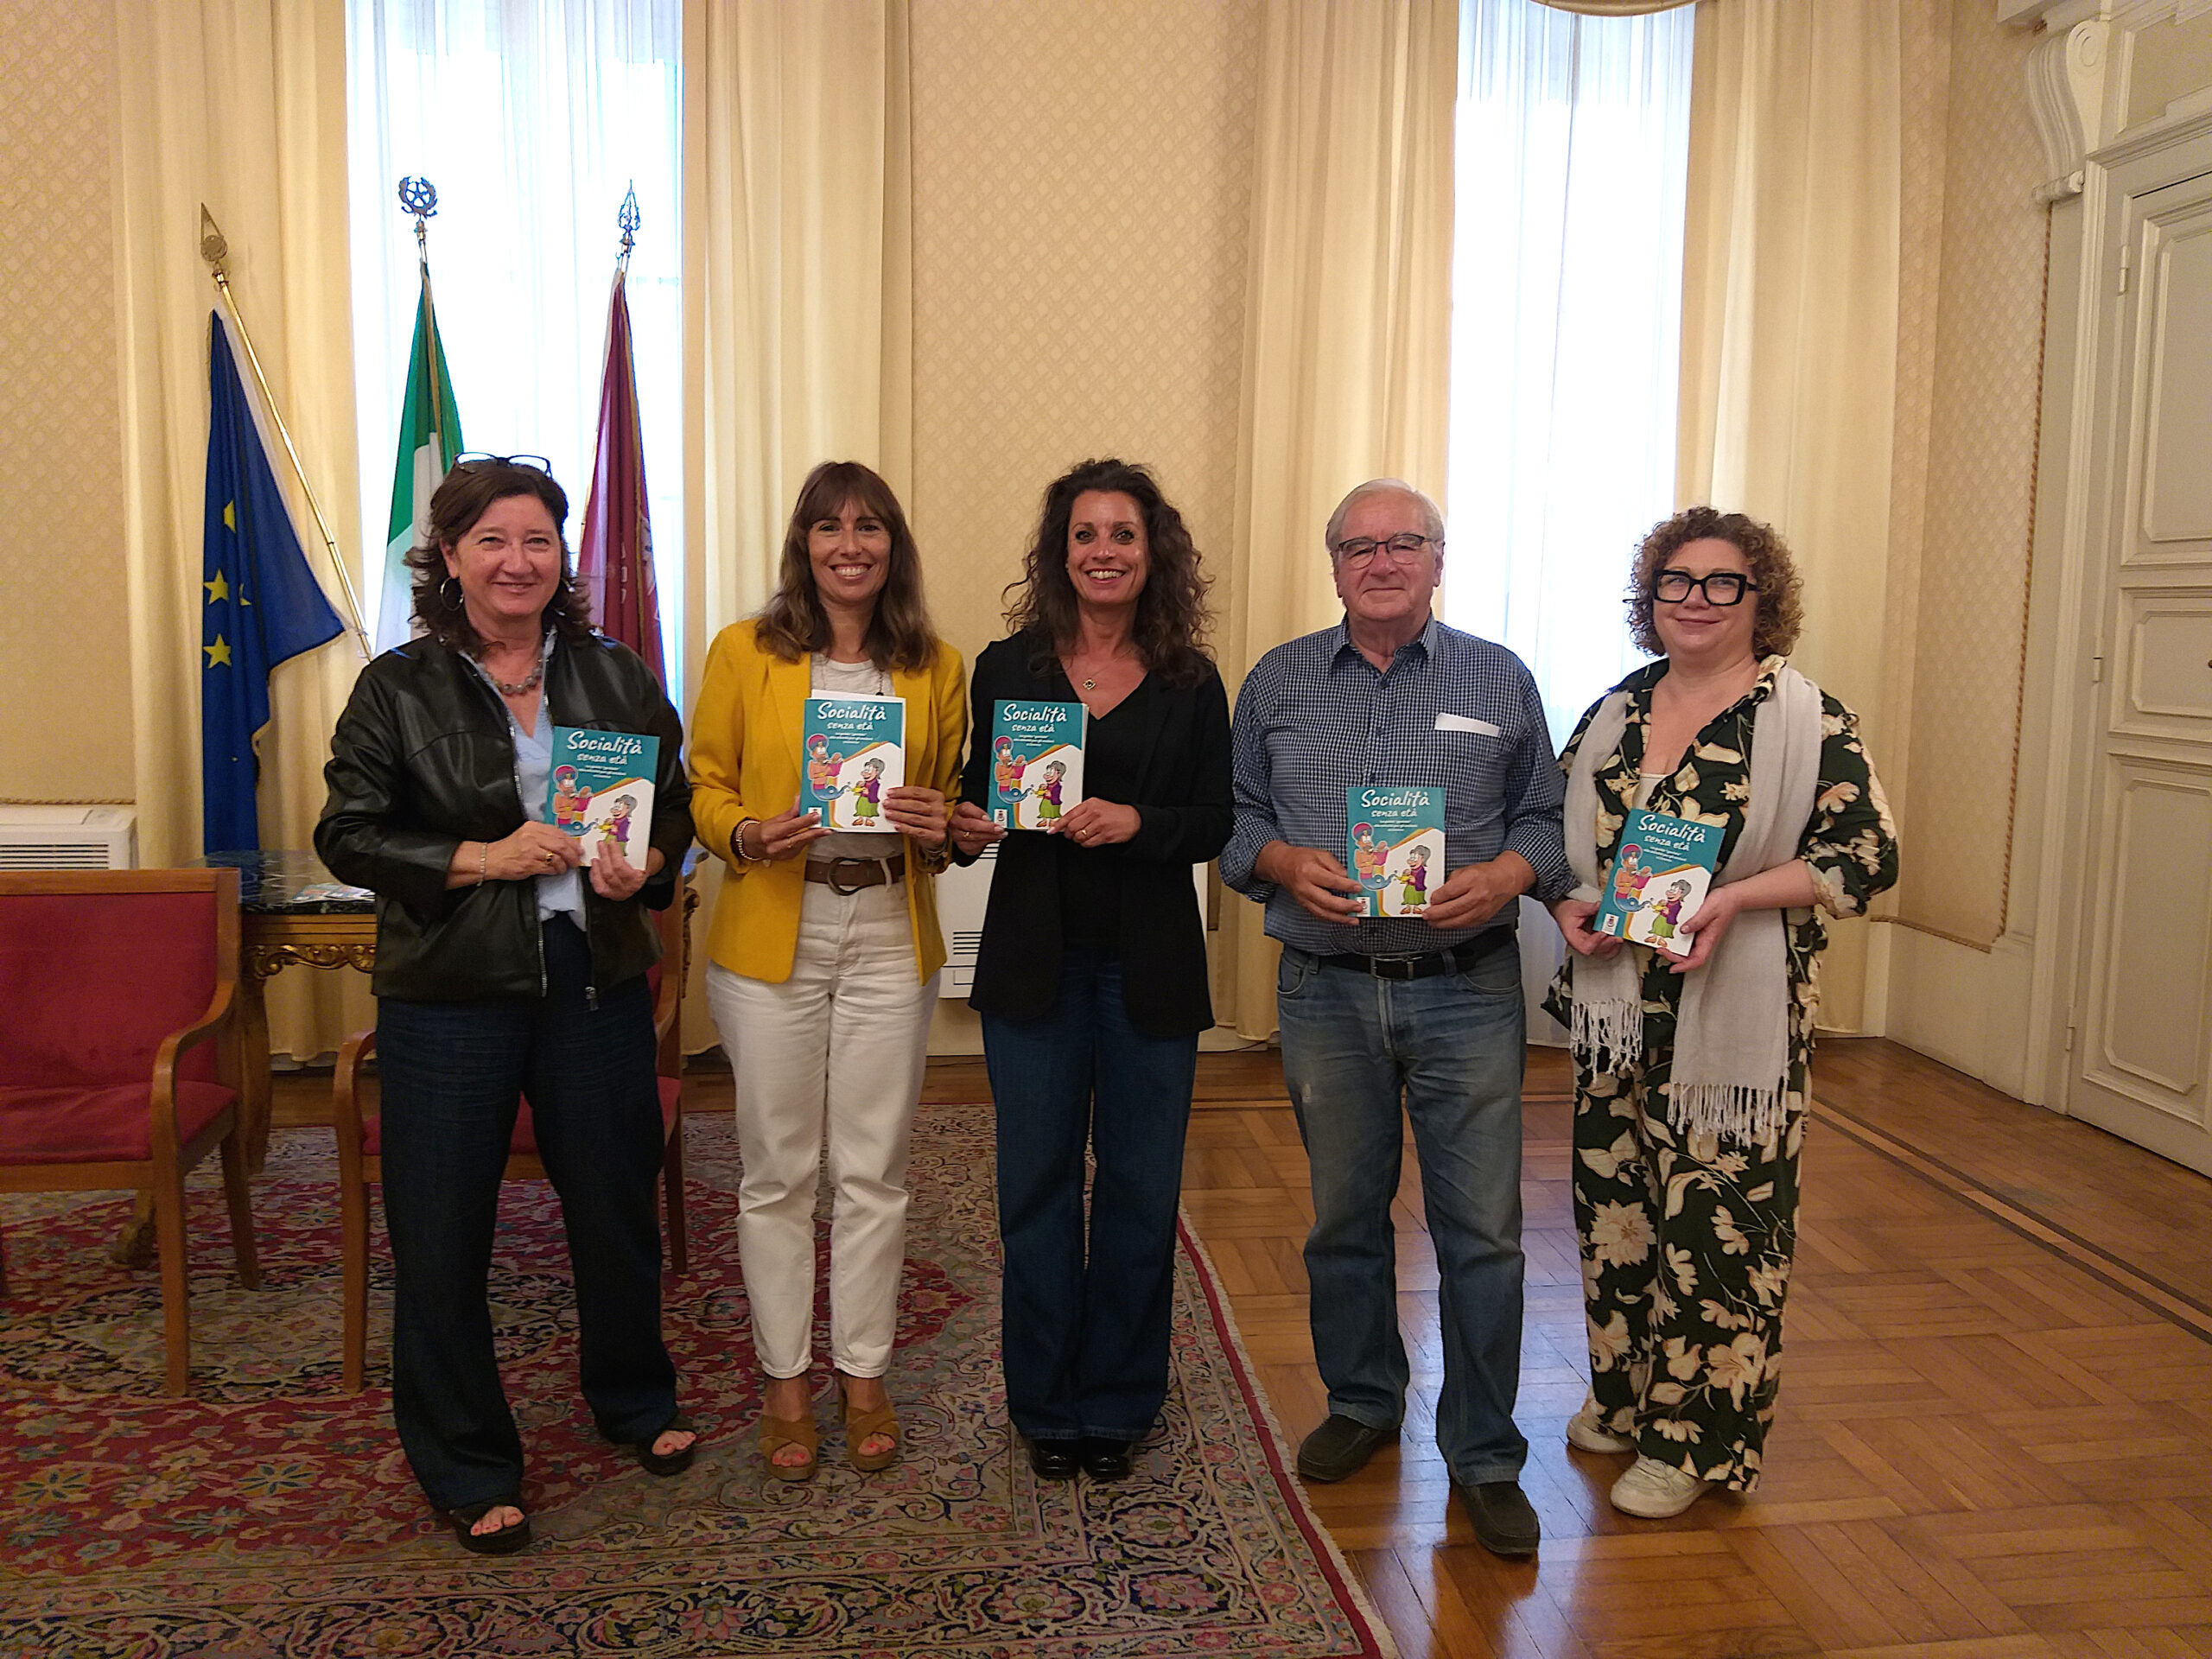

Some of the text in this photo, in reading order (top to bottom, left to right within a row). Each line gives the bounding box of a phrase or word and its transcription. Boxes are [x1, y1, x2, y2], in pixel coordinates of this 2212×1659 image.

[817, 701, 887, 721] Socialità
[1002, 702, 1068, 723] Socialità
[827, 721, 874, 731] senza età
[1011, 723, 1055, 733] senza età
[566, 730, 643, 755] Socialità
[576, 753, 628, 765] senza età
[1361, 789, 1431, 808] Socialità
[1400, 808, 1418, 817] età
[1637, 814, 1707, 843] Socialità
[1643, 835, 1672, 847] senza
[1673, 842, 1690, 852] età
